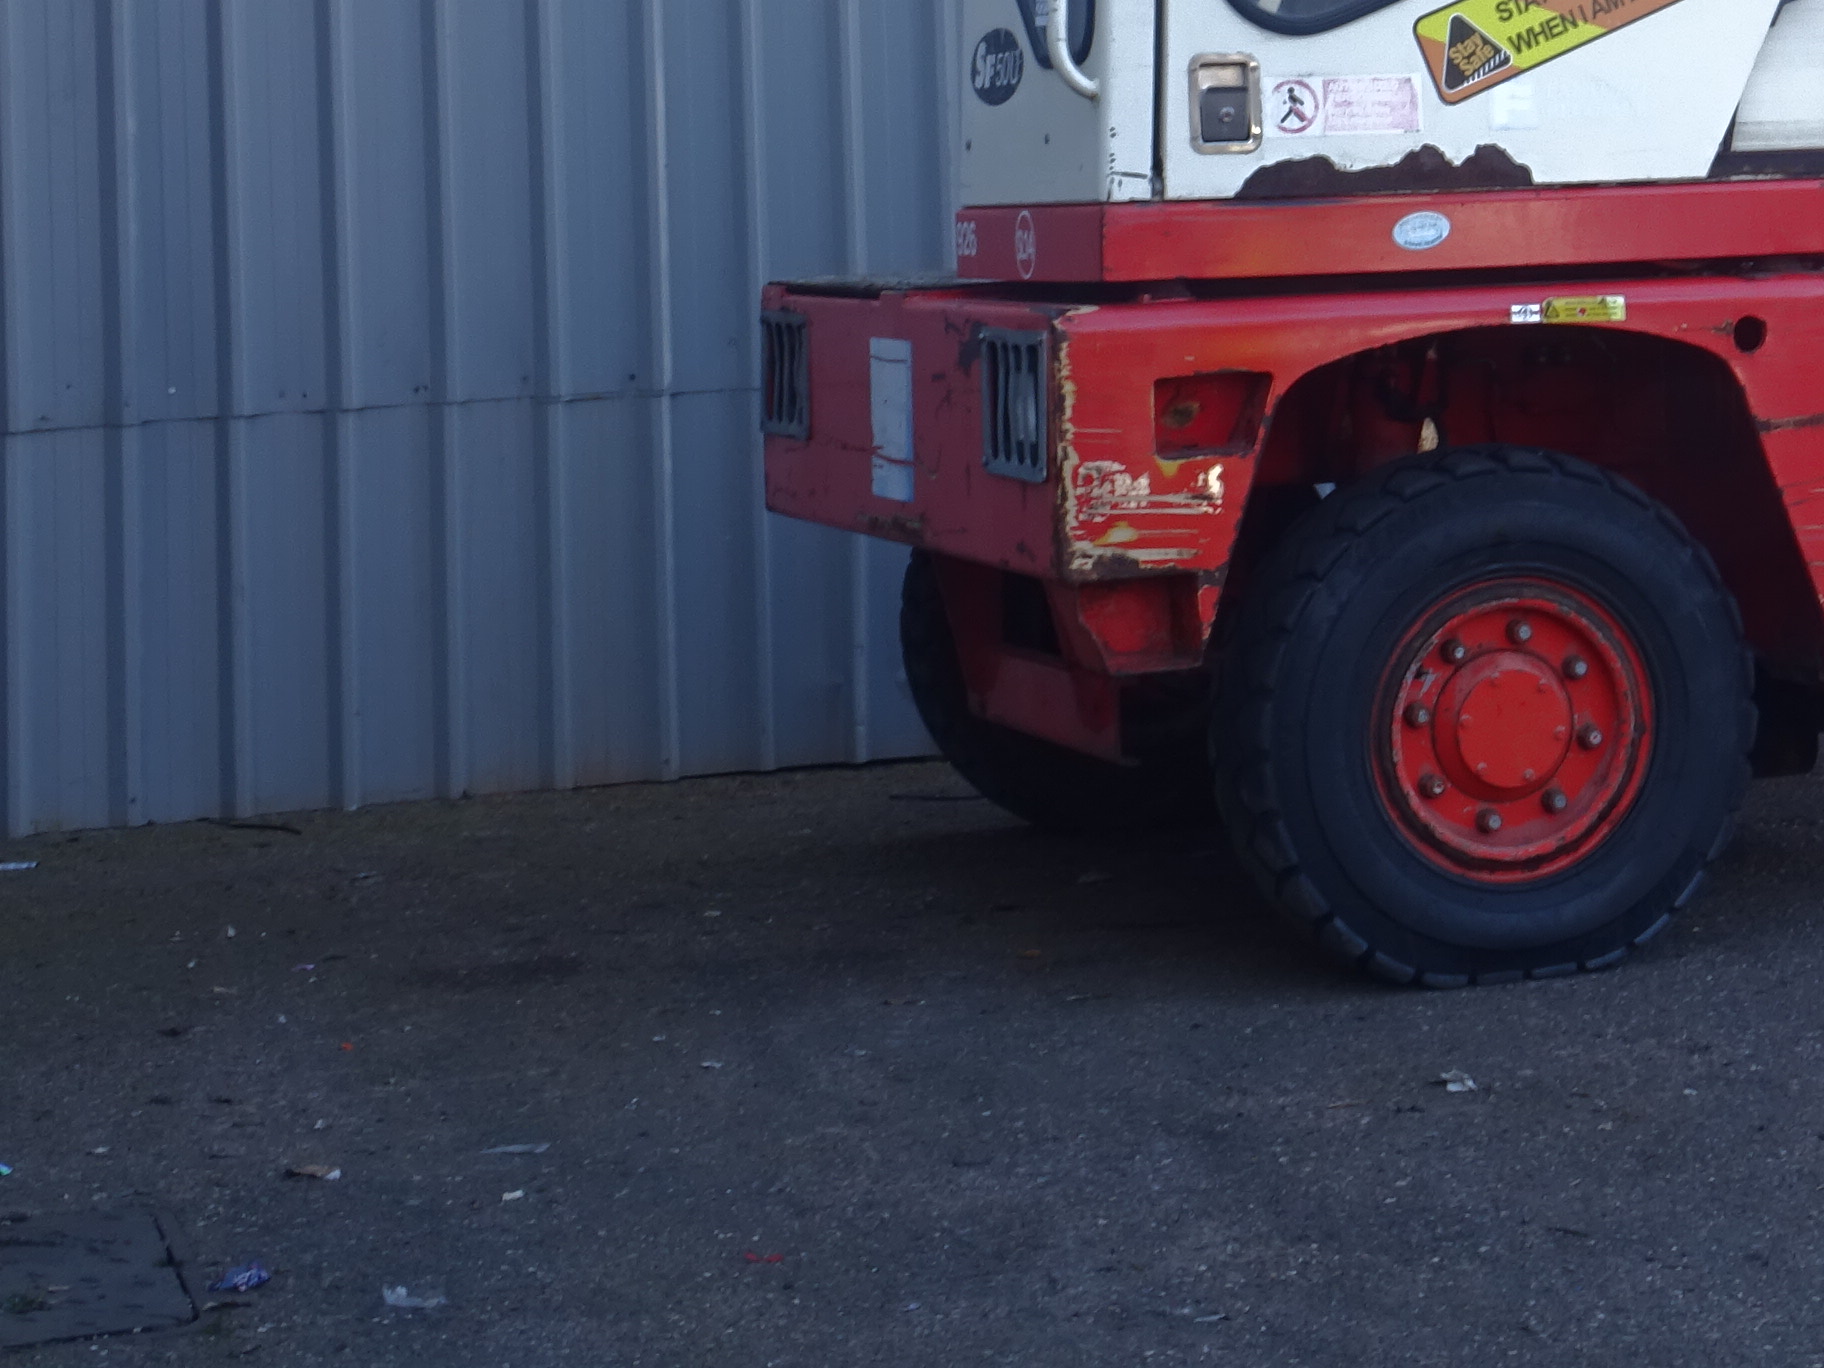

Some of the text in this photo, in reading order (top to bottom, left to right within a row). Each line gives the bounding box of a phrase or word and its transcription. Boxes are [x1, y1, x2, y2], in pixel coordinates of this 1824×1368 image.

[1506, 13, 1579, 55] WHEN
[1577, 6, 1589, 24] I
[1449, 32, 1483, 65] Stay
[1459, 44, 1495, 77] Safe
